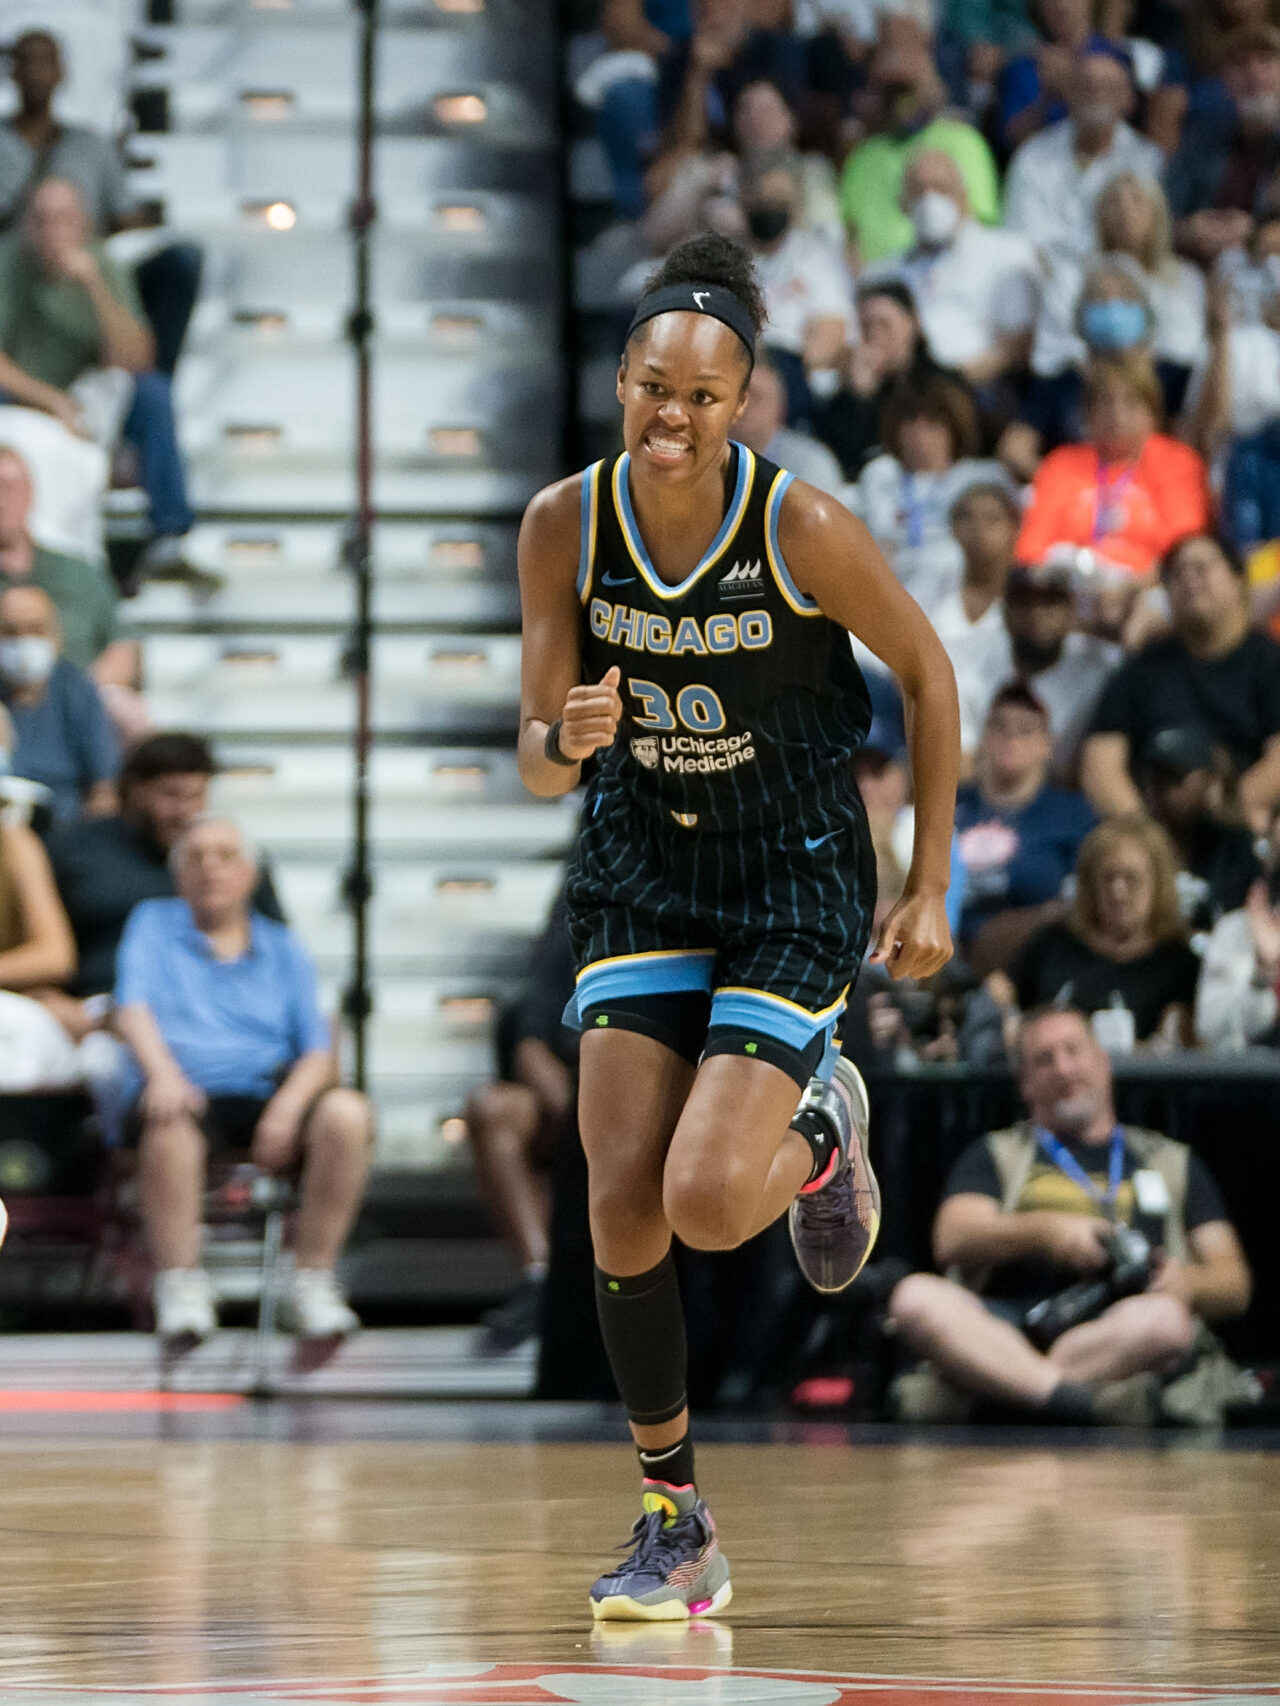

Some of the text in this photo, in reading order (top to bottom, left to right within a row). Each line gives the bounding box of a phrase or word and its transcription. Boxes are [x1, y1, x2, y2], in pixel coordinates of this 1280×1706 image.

[589, 597, 773, 656] CHICAGO
[627, 677, 726, 733] 30
[661, 731, 752, 754] UChicago
[663, 745, 755, 773] Medicine
